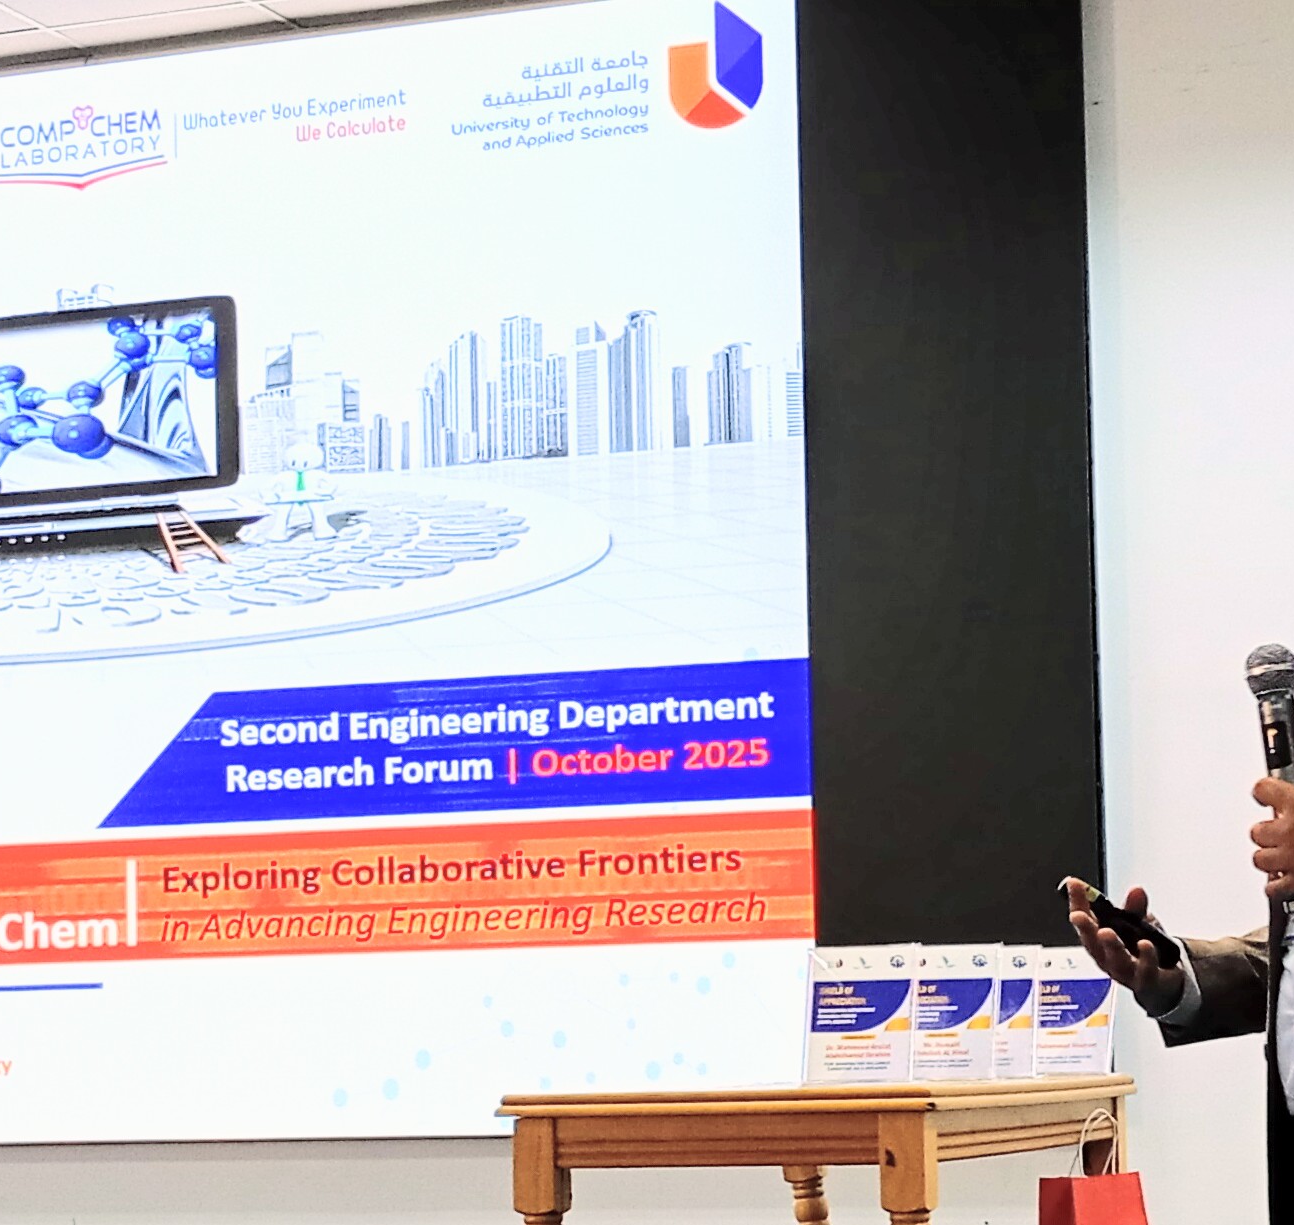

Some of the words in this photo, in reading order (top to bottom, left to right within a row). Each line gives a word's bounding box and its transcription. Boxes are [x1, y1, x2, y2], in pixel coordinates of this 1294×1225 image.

[521, 57, 584, 82] التقنية
[591, 50, 649, 71] جامعة
[482, 82, 572, 109] التطبيقية
[578, 73, 649, 100] والعلوم
[183, 109, 267, 130] Whatever
[271, 102, 303, 120] You
[307, 89, 407, 117] Experiment
[451, 117, 531, 136] University
[537, 111, 554, 126] of
[557, 104, 649, 124] Technology
[0, 120, 75, 148] COMP
[90, 109, 161, 138] CHEM
[296, 125, 322, 142] We
[326, 114, 407, 139] Calculate
[482, 137, 512, 151] and
[515, 128, 575, 149] Applied
[580, 123, 649, 140] Sciences
[1, 134, 160, 169] LABORATORY
[220, 711, 340, 747] Second
[349, 702, 551, 744] Engineering
[559, 691, 775, 733] Department
[226, 756, 375, 793] Research
[384, 756, 494, 785] Forum
[532, 743, 674, 777] October
[683, 738, 770, 770] 2025
[163, 861, 322, 898] Exploring
[332, 850, 565, 886] Collaborative
[578, 844, 742, 877] Frontiers
[161, 914, 190, 942] in
[198, 907, 376, 942] Advancing
[387, 900, 593, 940] Engineering
[605, 892, 766, 927] Research
